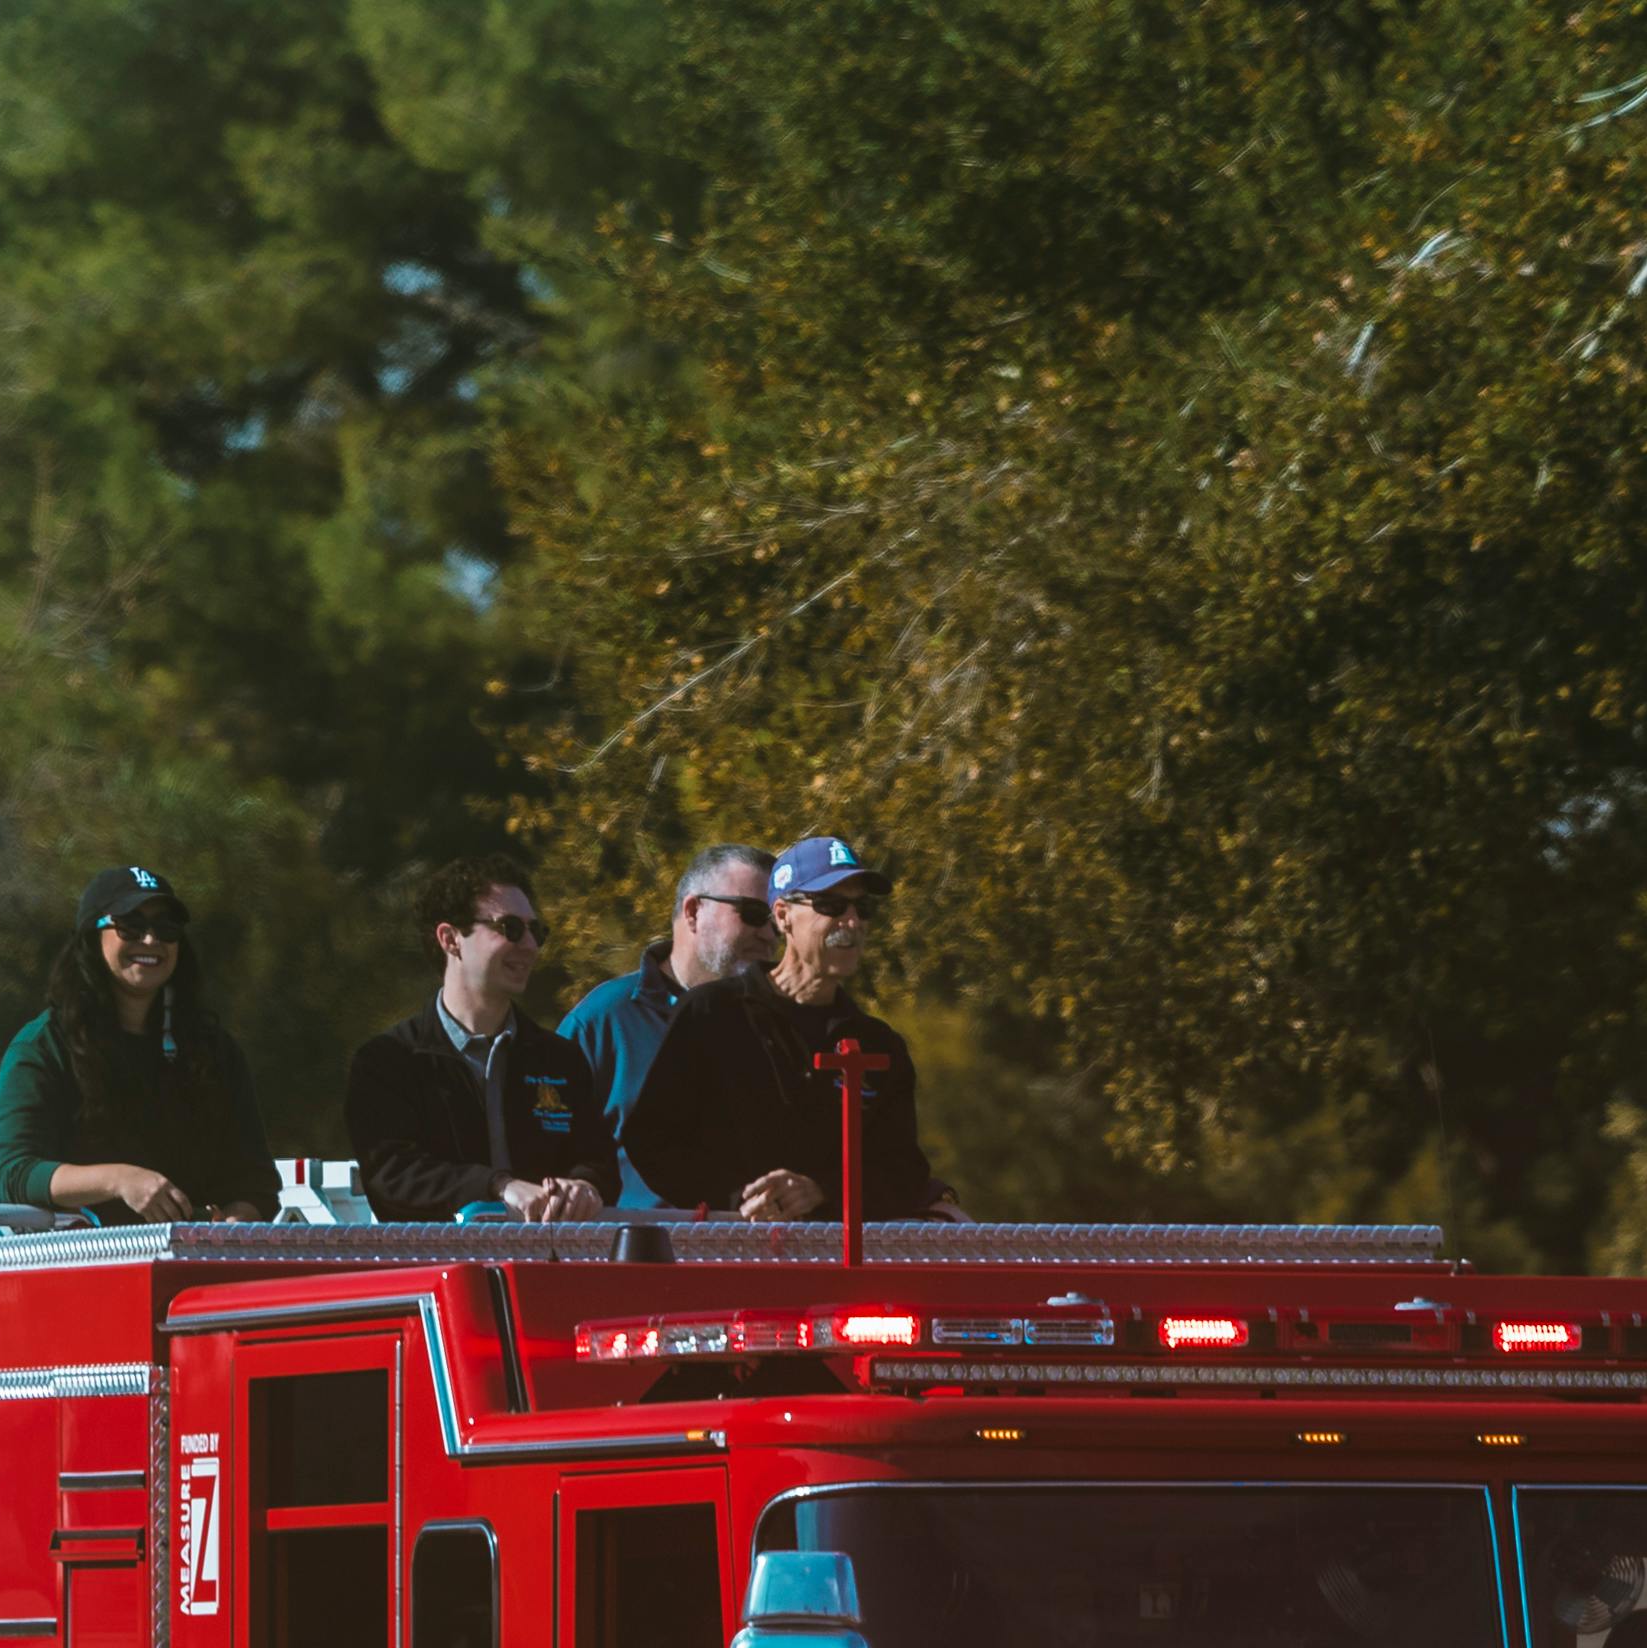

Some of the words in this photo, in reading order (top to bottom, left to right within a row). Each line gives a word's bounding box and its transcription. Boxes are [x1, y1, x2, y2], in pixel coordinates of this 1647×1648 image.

[130, 867, 158, 888] LA
[209, 1432, 220, 1453] BY
[180, 1464, 191, 1616] MEASURE
